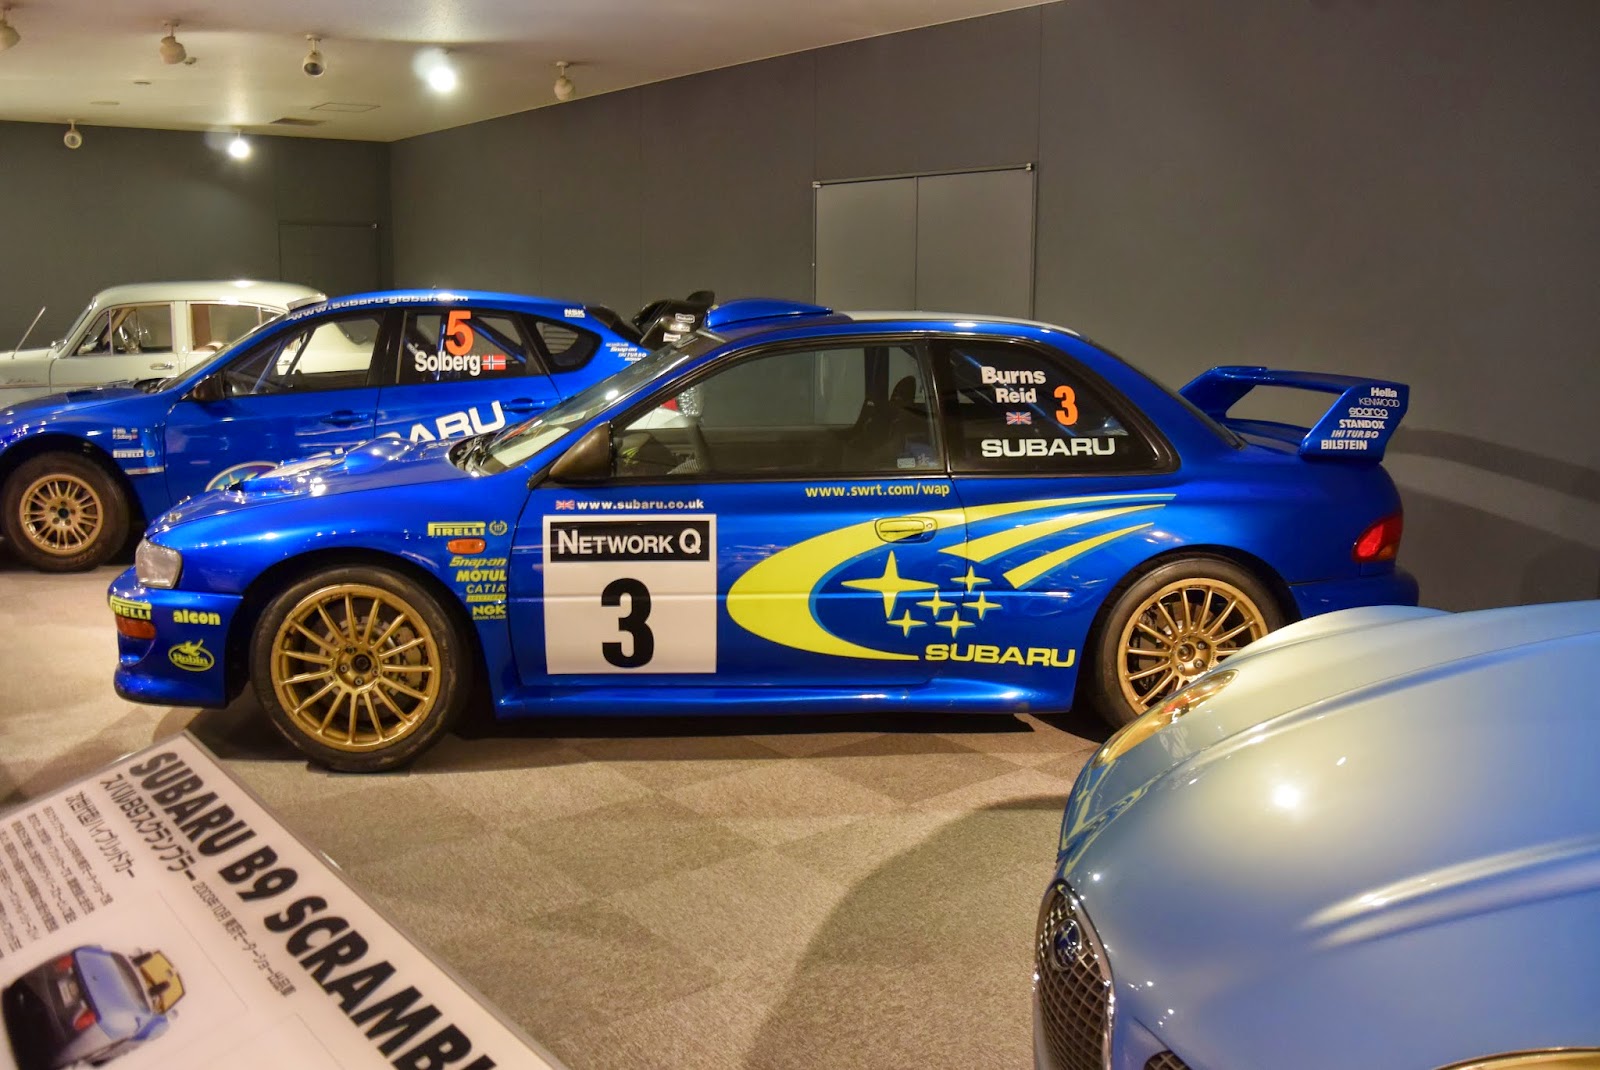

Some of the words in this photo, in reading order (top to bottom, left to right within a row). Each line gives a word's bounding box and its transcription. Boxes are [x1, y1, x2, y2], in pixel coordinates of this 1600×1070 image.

[290, 294, 469, 321] www.subaru-global.m
[445, 310, 474, 356] 5
[414, 350, 481, 376] Solberg
[981, 366, 1046, 385] Burns
[995, 387, 1037, 404] Reid
[1370, 387, 1398, 398] Hella
[1053, 385, 1079, 426] 3
[1358, 397, 1400, 408] KENWOOD
[1348, 407, 1389, 418] sparco
[1339, 419, 1386, 430] STANDOX
[1331, 429, 1345, 438] IHI
[1346, 429, 1379, 439] TURBO
[981, 437, 1116, 458] SUBARU
[1320, 439, 1368, 451] BILSTEIN
[805, 482, 950, 498] www.swrt.com/wap
[577, 498, 705, 510] www.subaru.co.uk
[427, 522, 486, 536] PIRELLI
[557, 529, 674, 555] NETWORK
[679, 527, 702, 555] Q
[449, 556, 507, 568] Snap-on
[456, 569, 507, 582] MOTUL
[466, 583, 506, 594] CATIA
[173, 608, 221, 626] alcon
[472, 604, 506, 616] NGK
[601, 577, 655, 669] 3
[924, 643, 1076, 668] SUBARU
[129, 752, 257, 857] SUBARU
[217, 844, 298, 902] B9
